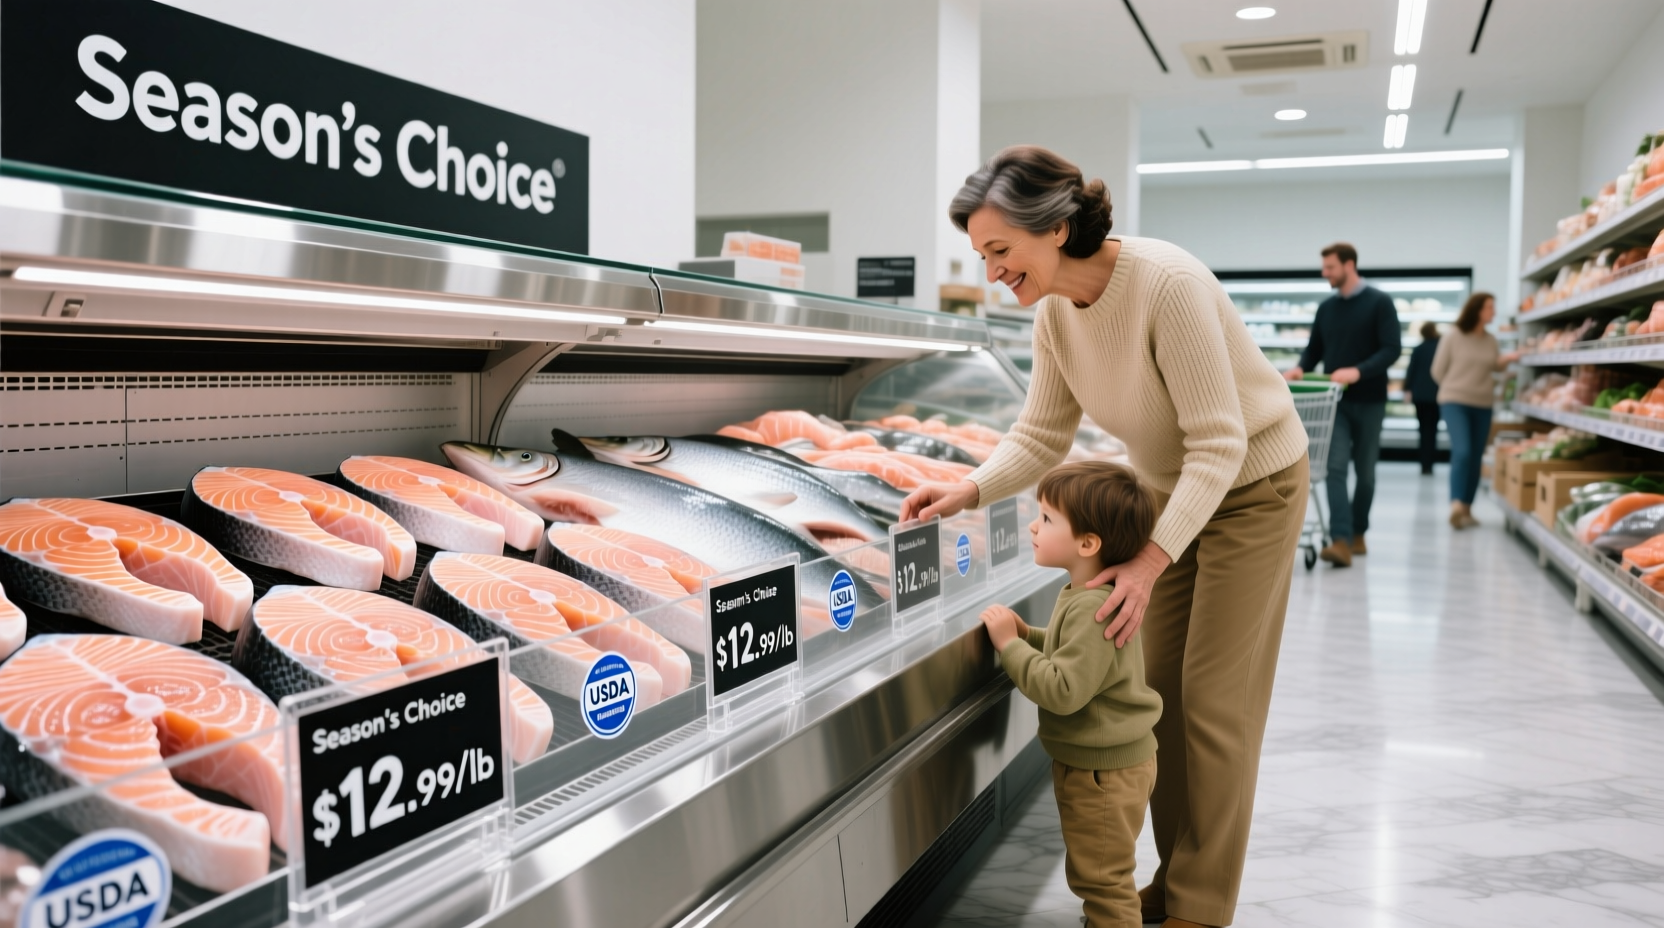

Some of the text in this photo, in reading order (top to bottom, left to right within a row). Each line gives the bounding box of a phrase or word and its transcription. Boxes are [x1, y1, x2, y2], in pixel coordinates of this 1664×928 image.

[75, 33, 383, 178] Season's
[716, 621, 794, 672] $12.99/lb
[589, 677, 630, 706] USDA
[312, 692, 467, 755] Season's Choice
[312, 747, 495, 848] $12.99/lb
[46, 871, 149, 928] USDA
